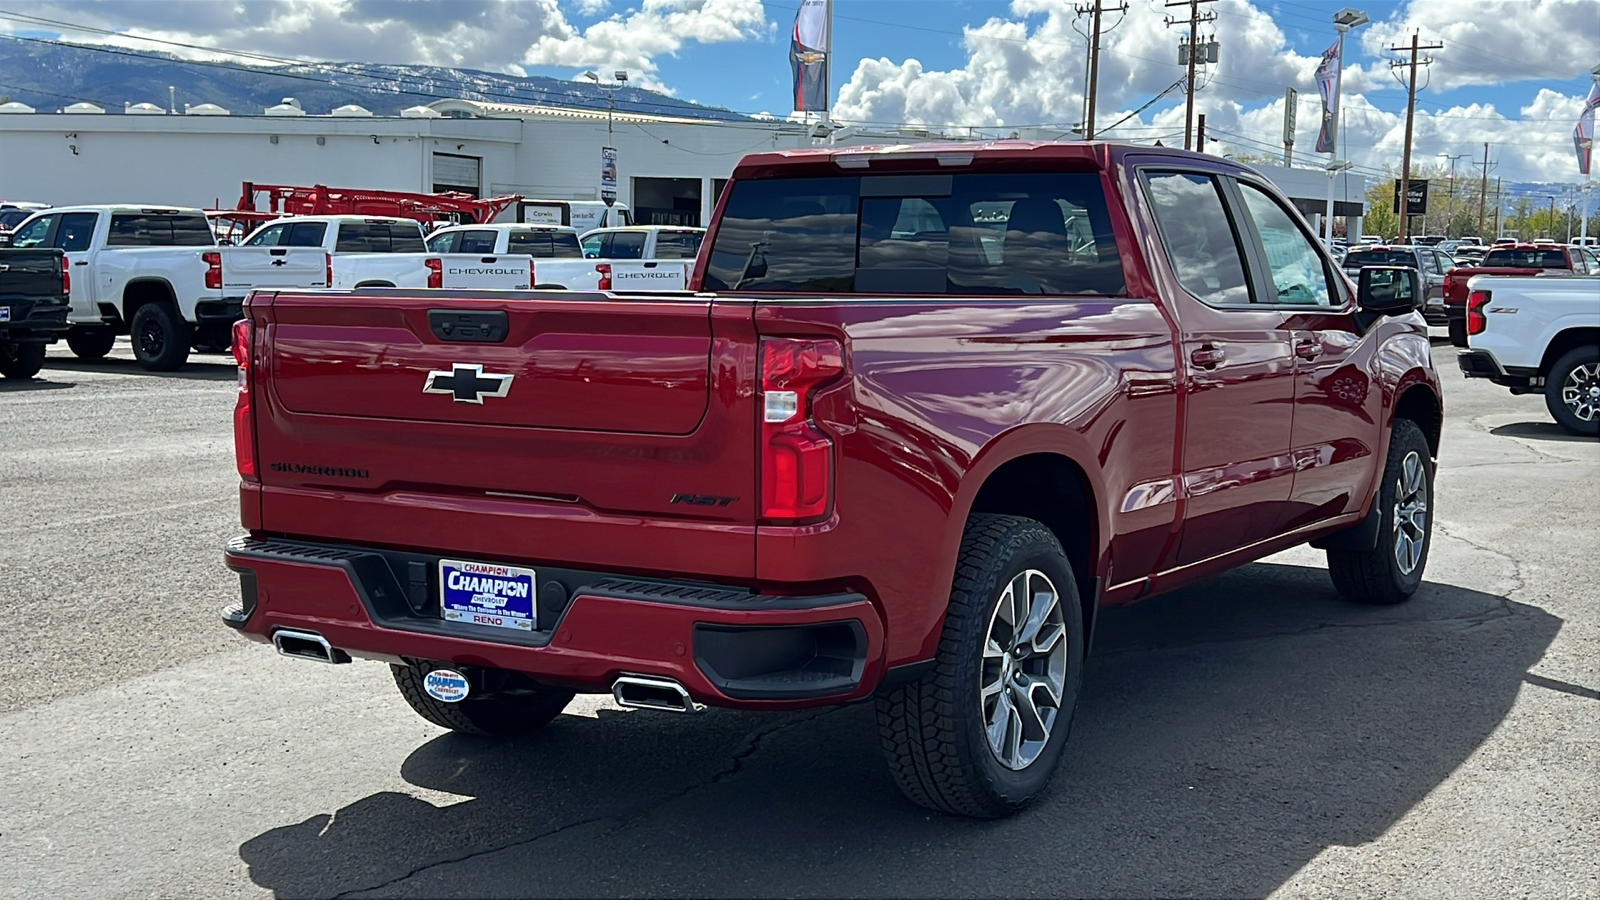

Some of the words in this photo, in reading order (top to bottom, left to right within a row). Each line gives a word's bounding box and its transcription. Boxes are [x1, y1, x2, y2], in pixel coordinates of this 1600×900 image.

[270, 462, 370, 478] SILVERADO
[670, 493, 740, 507] RST
[464, 564, 508, 576] CHAMPION
[448, 570, 528, 598] CHAMPION
[474, 596, 505, 604] CHEVROLET
[474, 616, 502, 626] RENO
